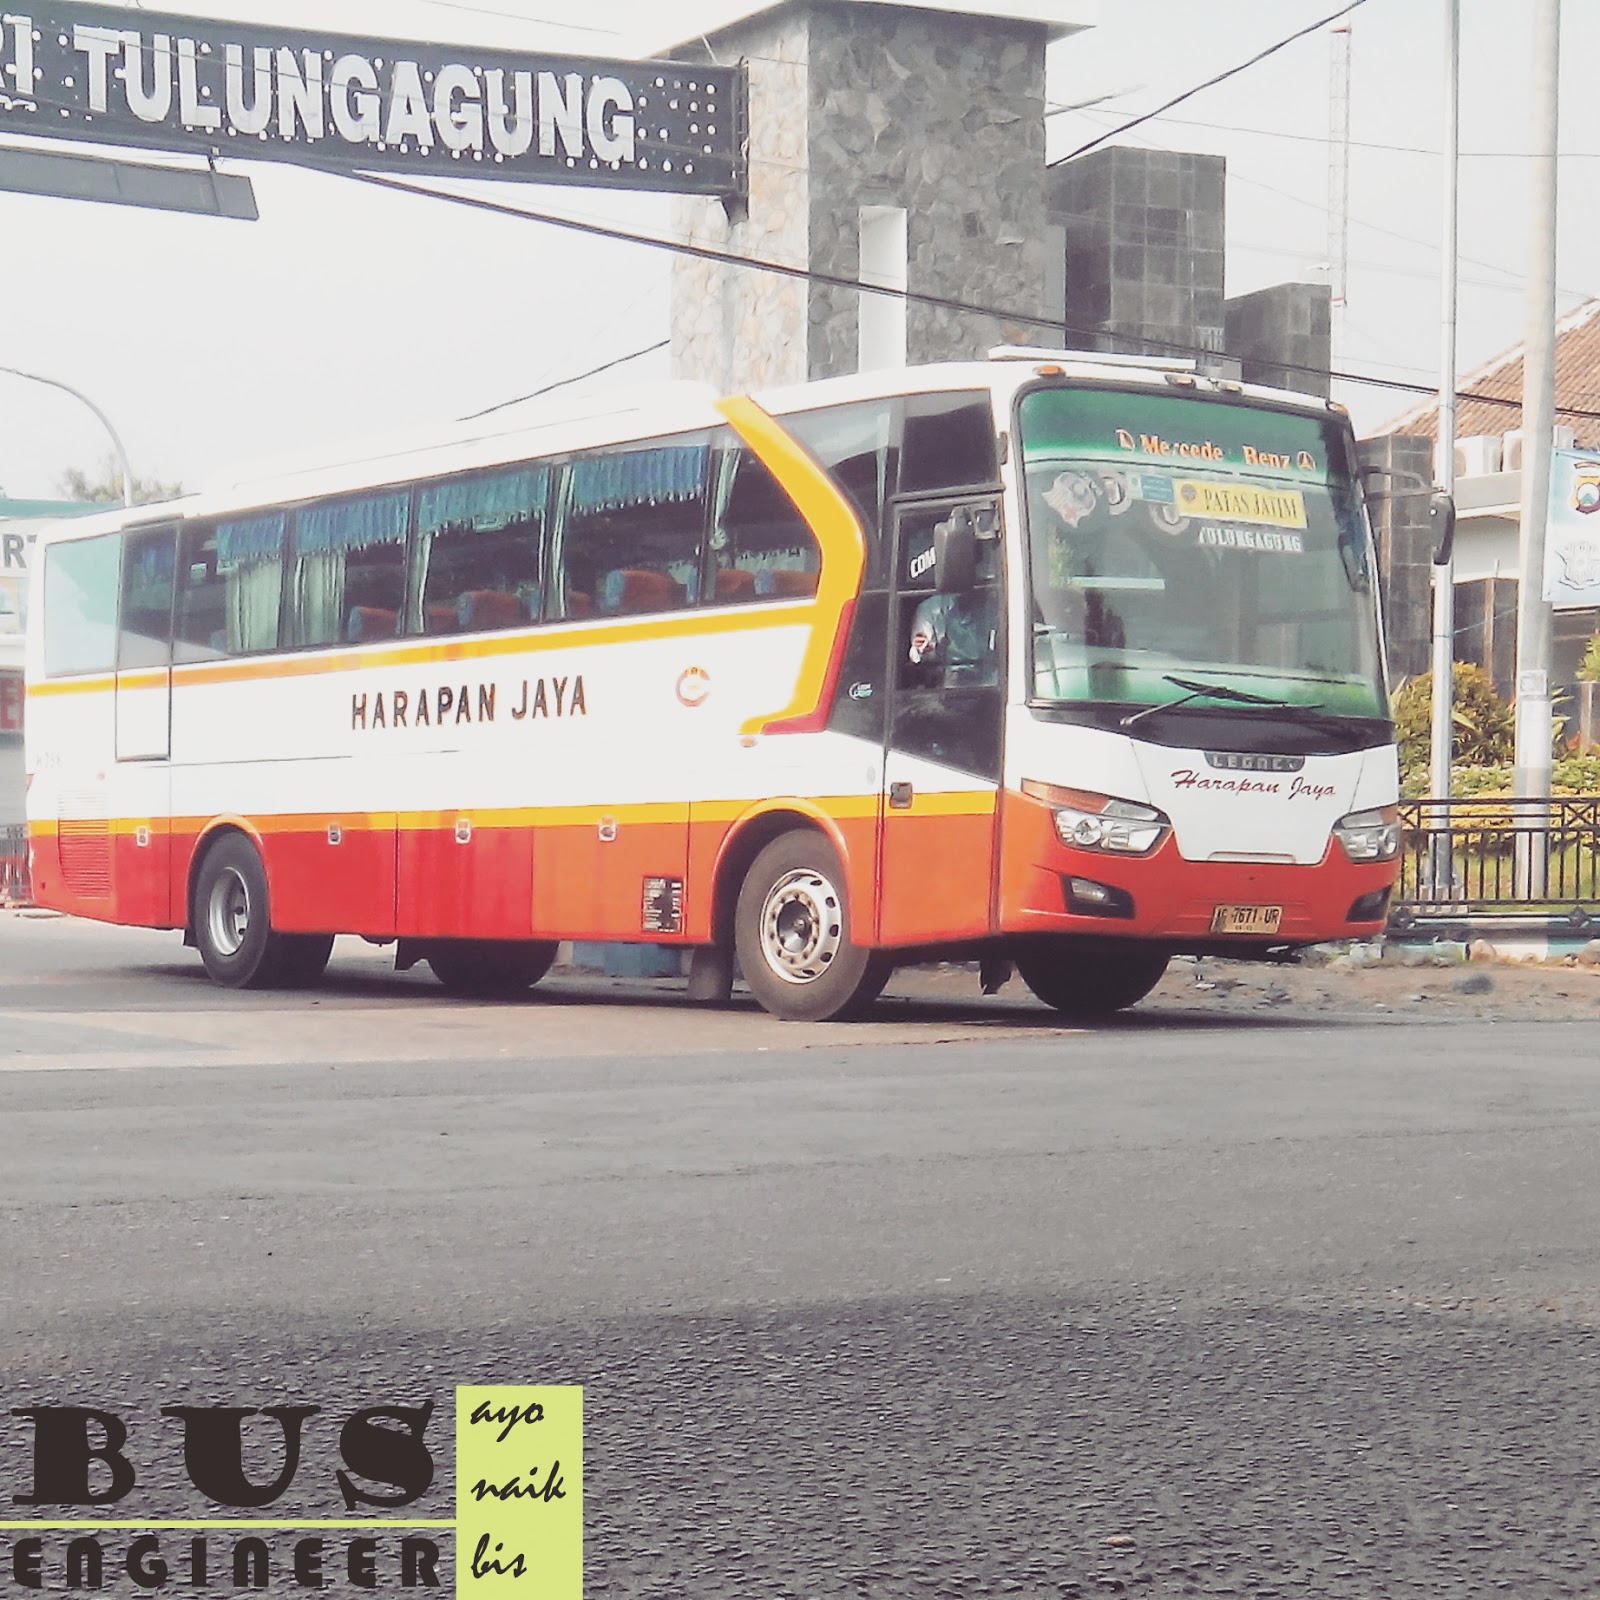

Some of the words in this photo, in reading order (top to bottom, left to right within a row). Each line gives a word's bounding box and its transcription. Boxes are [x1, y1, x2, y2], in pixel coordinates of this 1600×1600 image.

[73, 24, 635, 163] TULUNGAGUNG
[1204, 488, 1250, 513] PATAS
[1252, 493, 1298, 519] JATIM
[352, 682, 496, 730] HARAPAN
[511, 674, 587, 720] JAYA
[1170, 769, 1280, 796] Harapan
[1288, 776, 1336, 801] Jaya
[1233, 907, 1258, 924] 7671
[1264, 908, 1280, 925] UR
